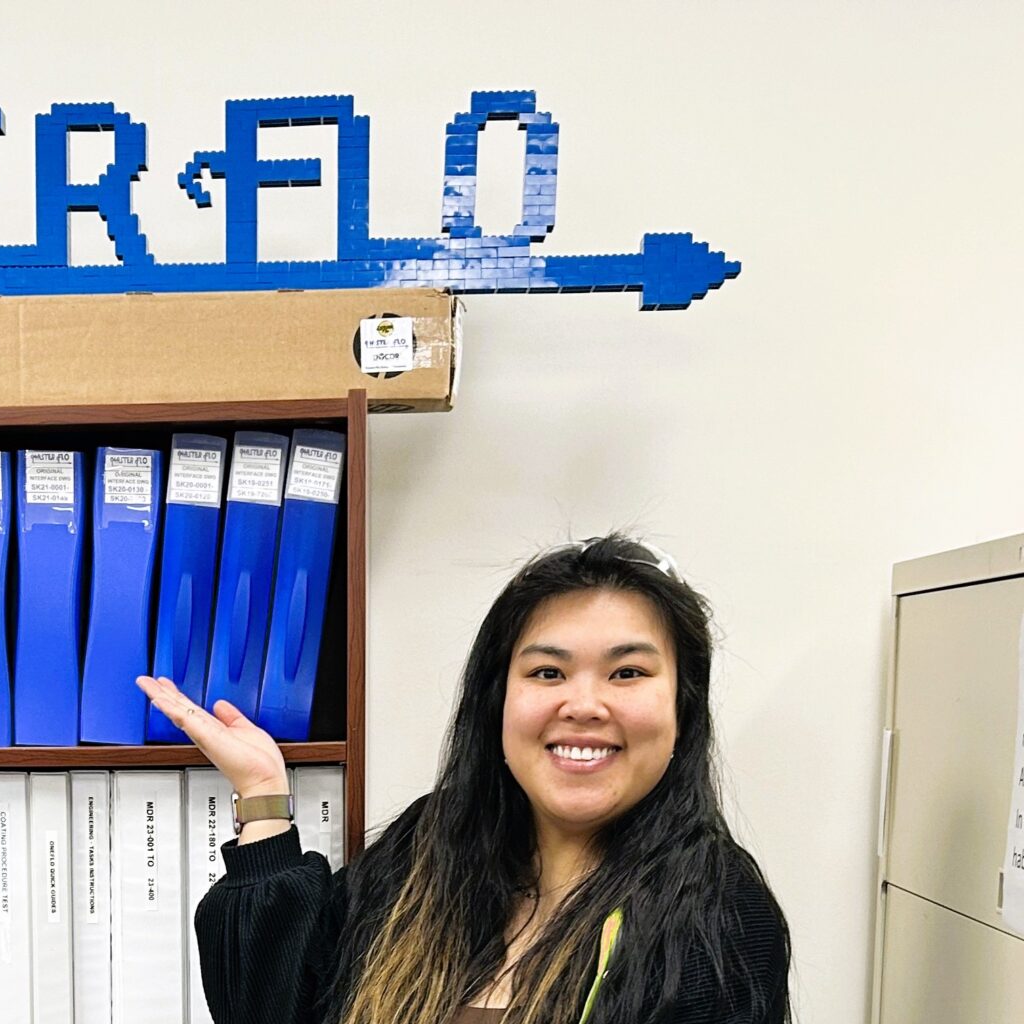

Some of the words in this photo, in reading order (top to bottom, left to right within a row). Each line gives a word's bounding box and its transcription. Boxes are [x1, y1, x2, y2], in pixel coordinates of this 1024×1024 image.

[179, 93, 561, 265] FLO
[146, 801, 154, 822] MDR
[208, 796, 216, 817] MDR
[321, 801, 329, 823] MDR
[0, 811, 7, 845] COATING
[147, 824, 155, 852] 23-001
[208, 819, 216, 847] 22-180
[147, 855, 155, 868] TO
[208, 850, 216, 862] TO
